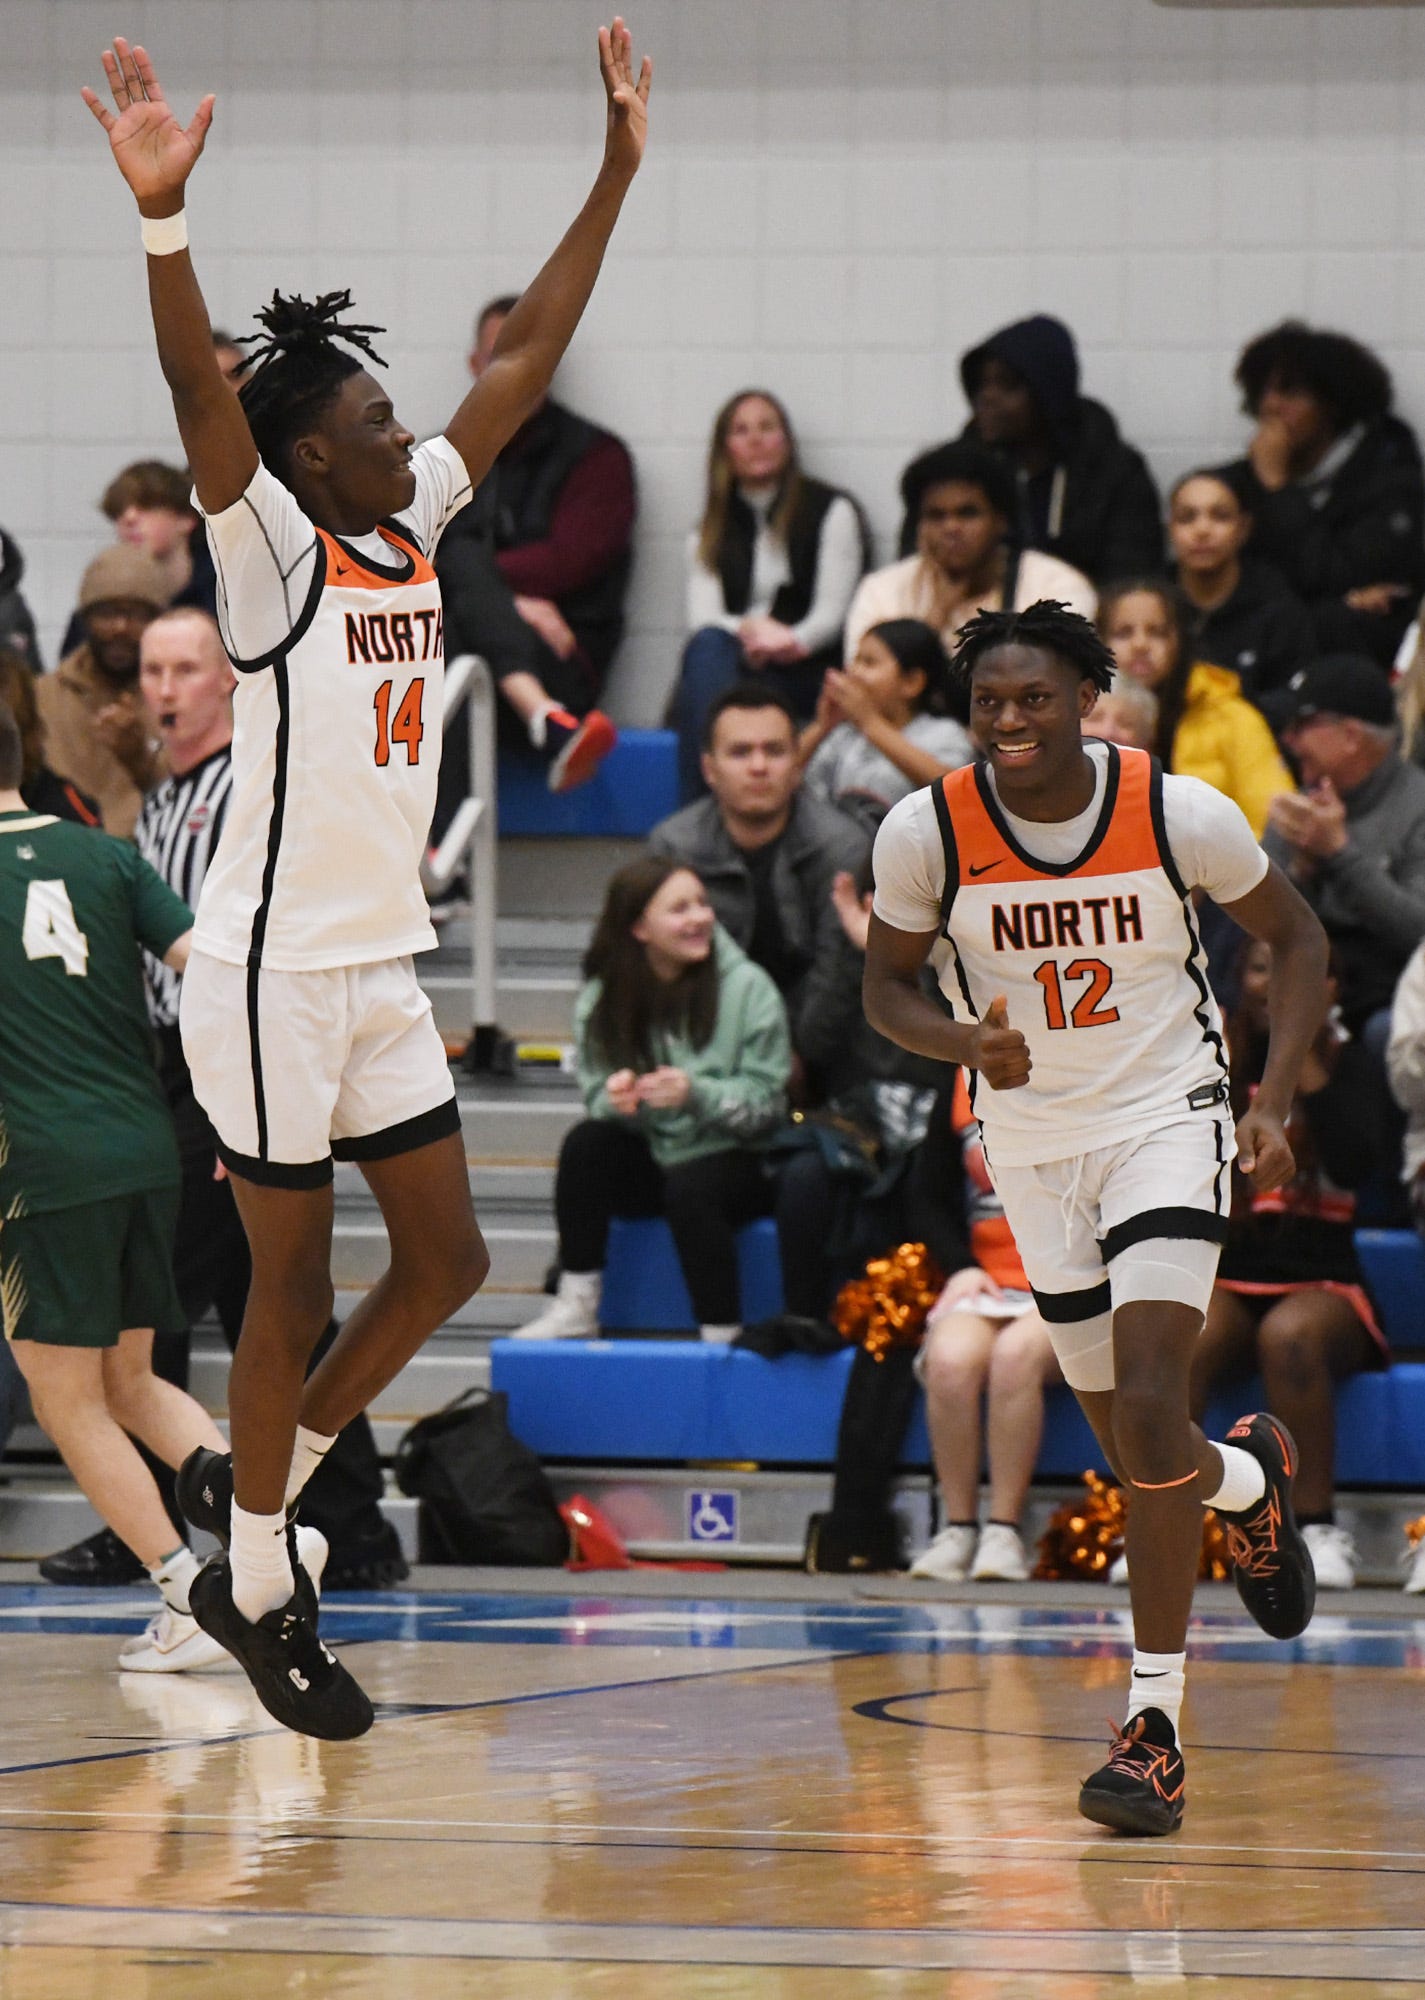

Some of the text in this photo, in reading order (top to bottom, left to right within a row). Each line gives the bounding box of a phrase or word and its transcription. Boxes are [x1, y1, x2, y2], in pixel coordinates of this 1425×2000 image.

[345, 608, 443, 664] NORTH
[373, 678, 425, 767] 14
[22, 879, 89, 977] 4
[991, 894, 1143, 952] NORTH
[1033, 958, 1121, 1030] 12
